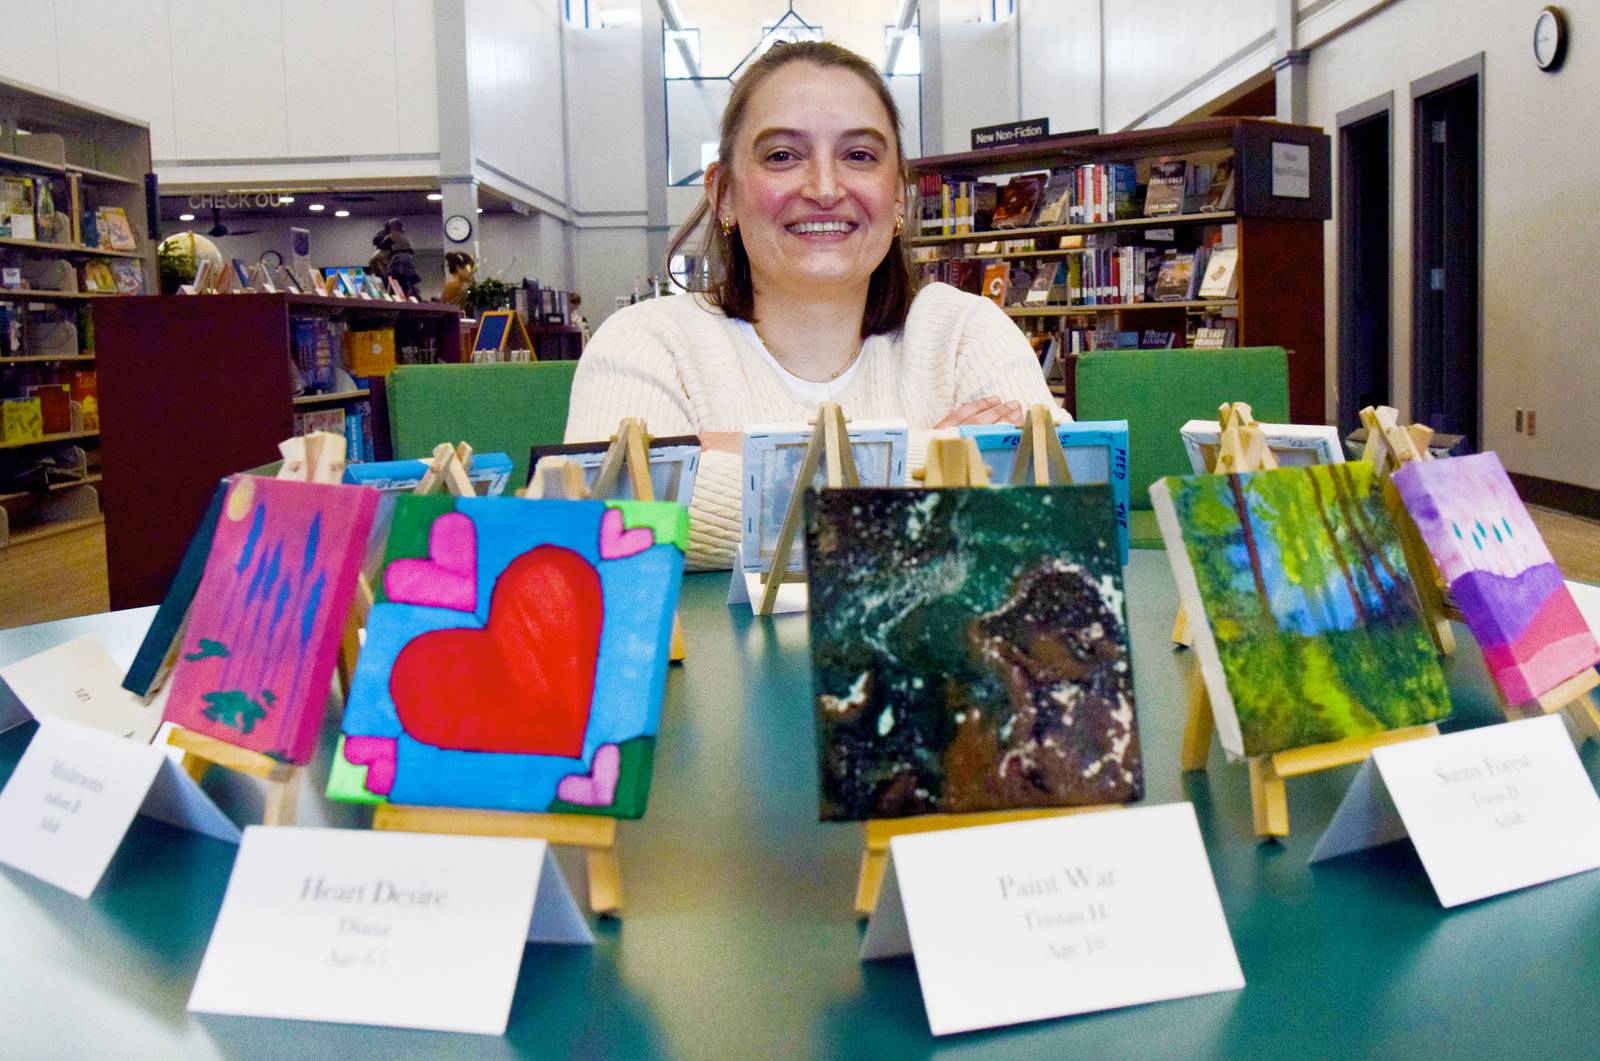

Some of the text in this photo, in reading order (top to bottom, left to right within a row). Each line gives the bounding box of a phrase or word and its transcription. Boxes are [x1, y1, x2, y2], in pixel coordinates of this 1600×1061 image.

[976, 125, 1042, 144] New Non-Fiction
[188, 192, 251, 209] CHECK
[300, 876, 449, 908] Heart Desire
[997, 865, 1117, 900] Paint War
[1046, 940, 1077, 962] Age
